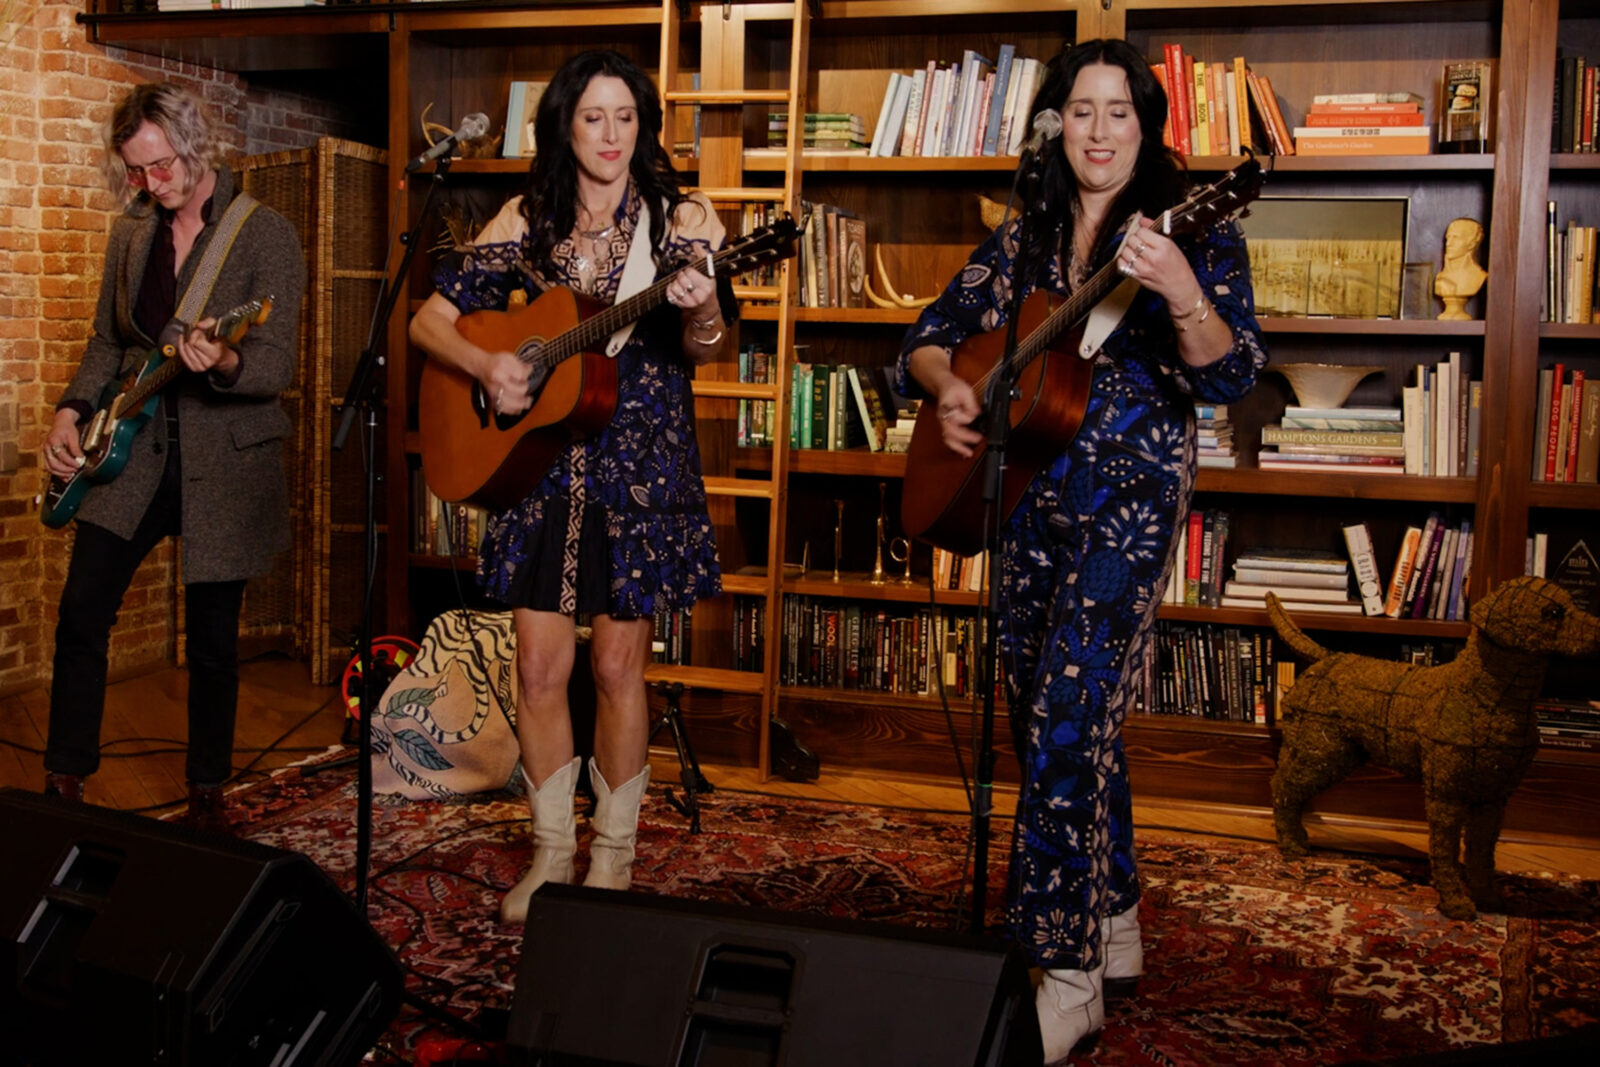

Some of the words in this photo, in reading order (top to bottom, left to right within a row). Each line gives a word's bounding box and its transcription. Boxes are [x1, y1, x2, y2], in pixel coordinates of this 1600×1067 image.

[1196, 73, 1204, 87] THE
[1198, 103, 1206, 124] BOOK
[1551, 399, 1560, 422] DOG
[1268, 432, 1326, 444] HAMPTONS
[1328, 433, 1378, 445] GARDENS
[1548, 425, 1558, 462] PEOPLE
[1202, 531, 1212, 556] FEEDING
[1202, 558, 1211, 570] THE
[1201, 570, 1211, 584] FIRE
[826, 615, 836, 647] WOOL
